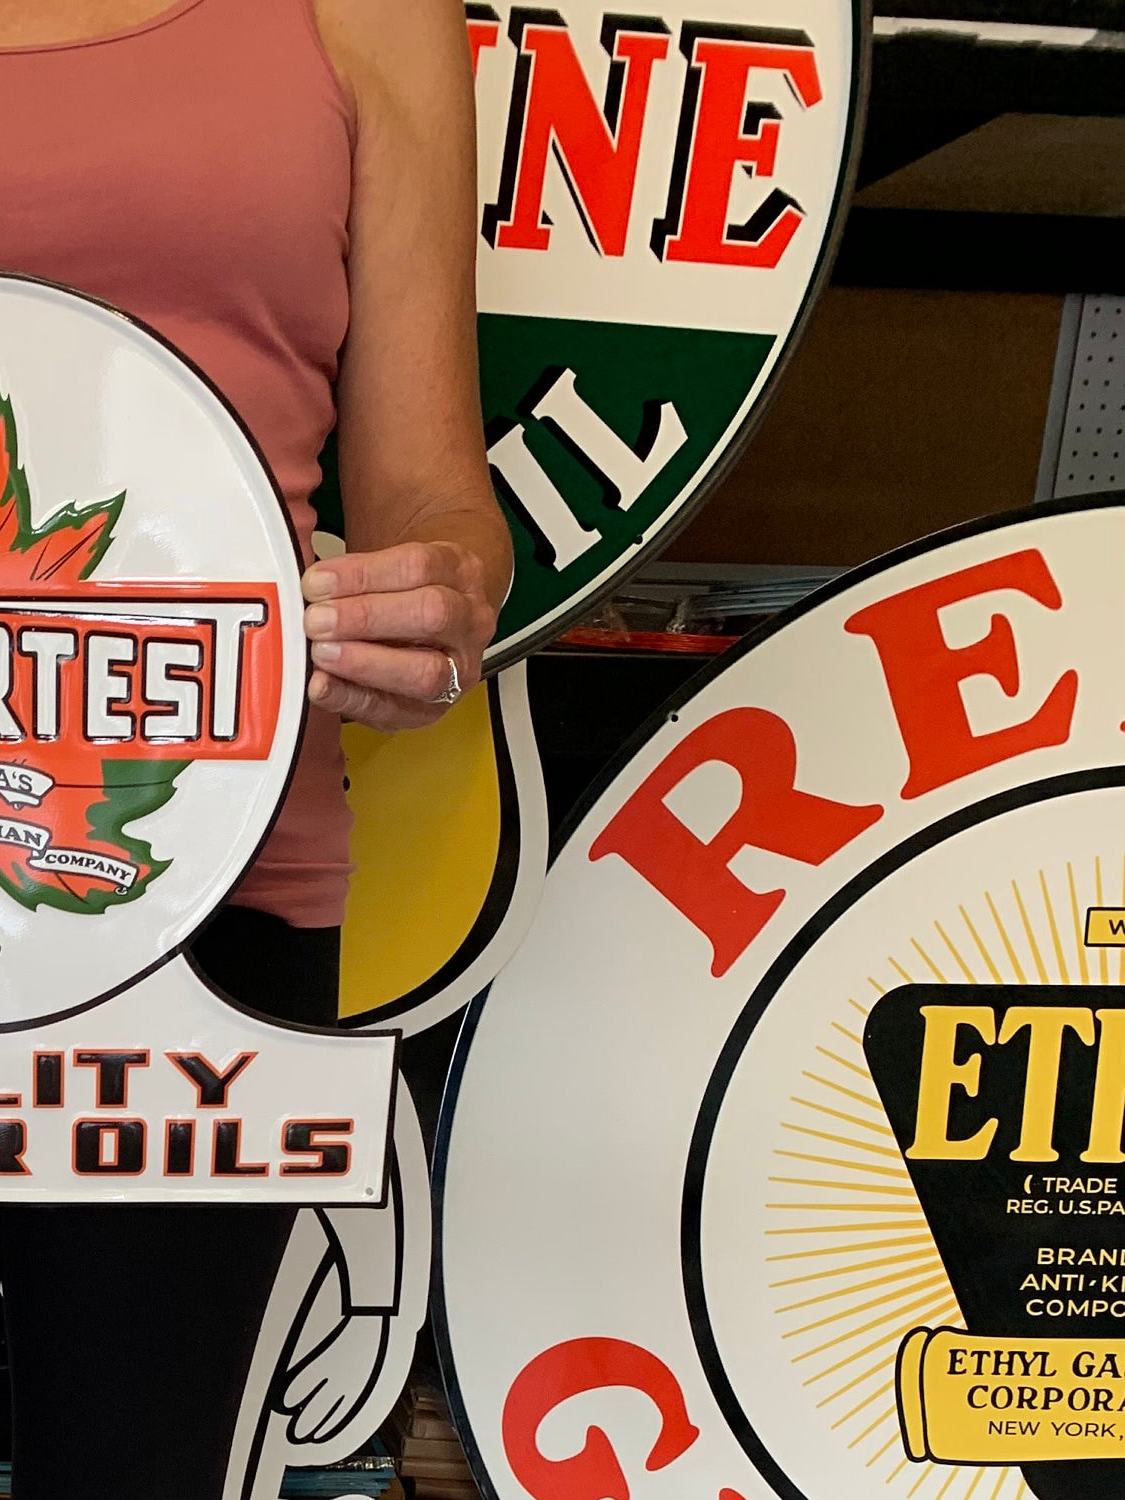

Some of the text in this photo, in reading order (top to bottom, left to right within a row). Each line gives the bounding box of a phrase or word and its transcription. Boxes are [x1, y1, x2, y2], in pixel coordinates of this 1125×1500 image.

[44, 853, 132, 882] COMPANY
[73, 1115, 357, 1178] OILS
[1042, 1177, 1118, 1194] TRADE
[1006, 1199, 1054, 1214] REG.
[1019, 1273, 1125, 1293] ANTI-K
[947, 1349, 1057, 1377] ETHYL
[967, 1385, 1125, 1412] CORPOR
[988, 1420, 1124, 1441] NEW YORK,
